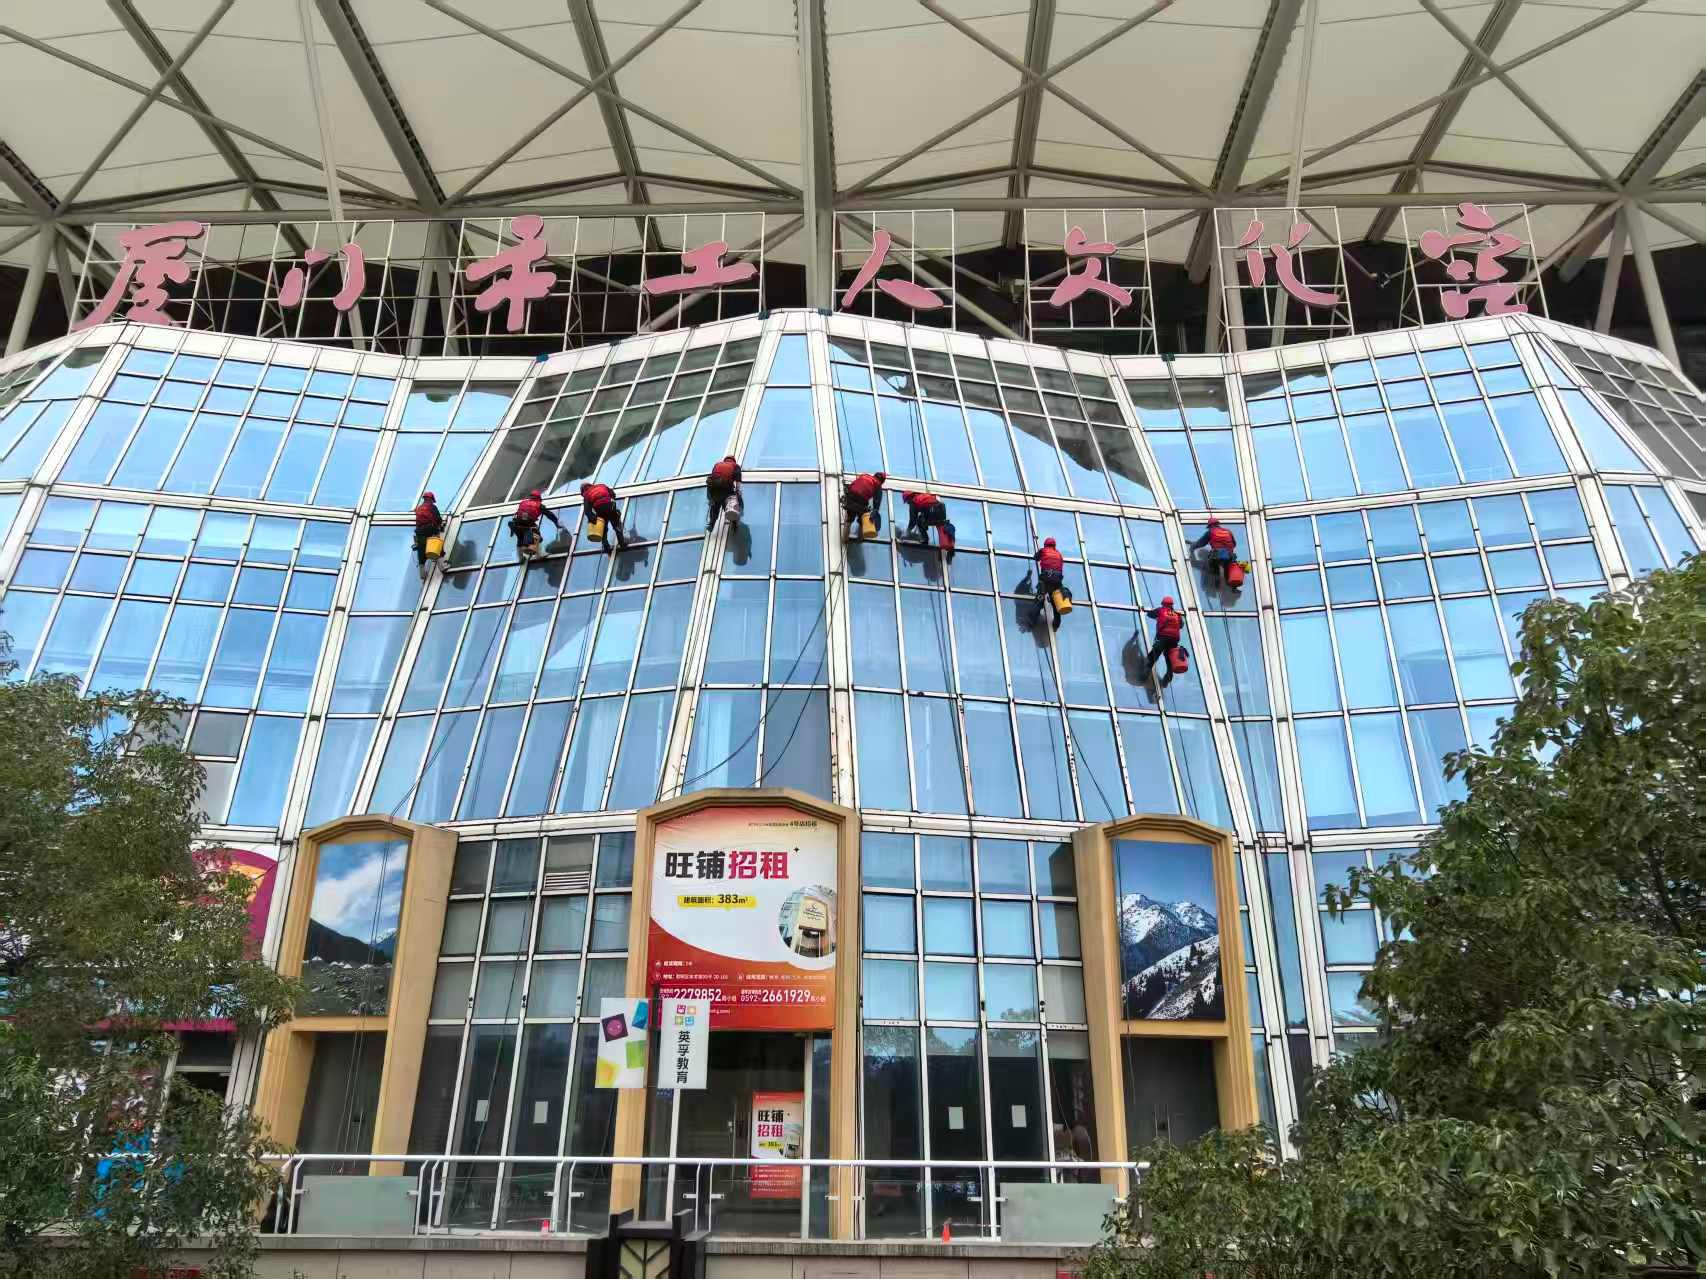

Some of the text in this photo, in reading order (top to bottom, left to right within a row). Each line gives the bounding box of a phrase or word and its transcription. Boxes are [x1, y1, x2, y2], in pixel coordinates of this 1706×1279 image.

[665, 850, 790, 880] 旺铺招租
[676, 1030, 691, 1084] 英孚教育
